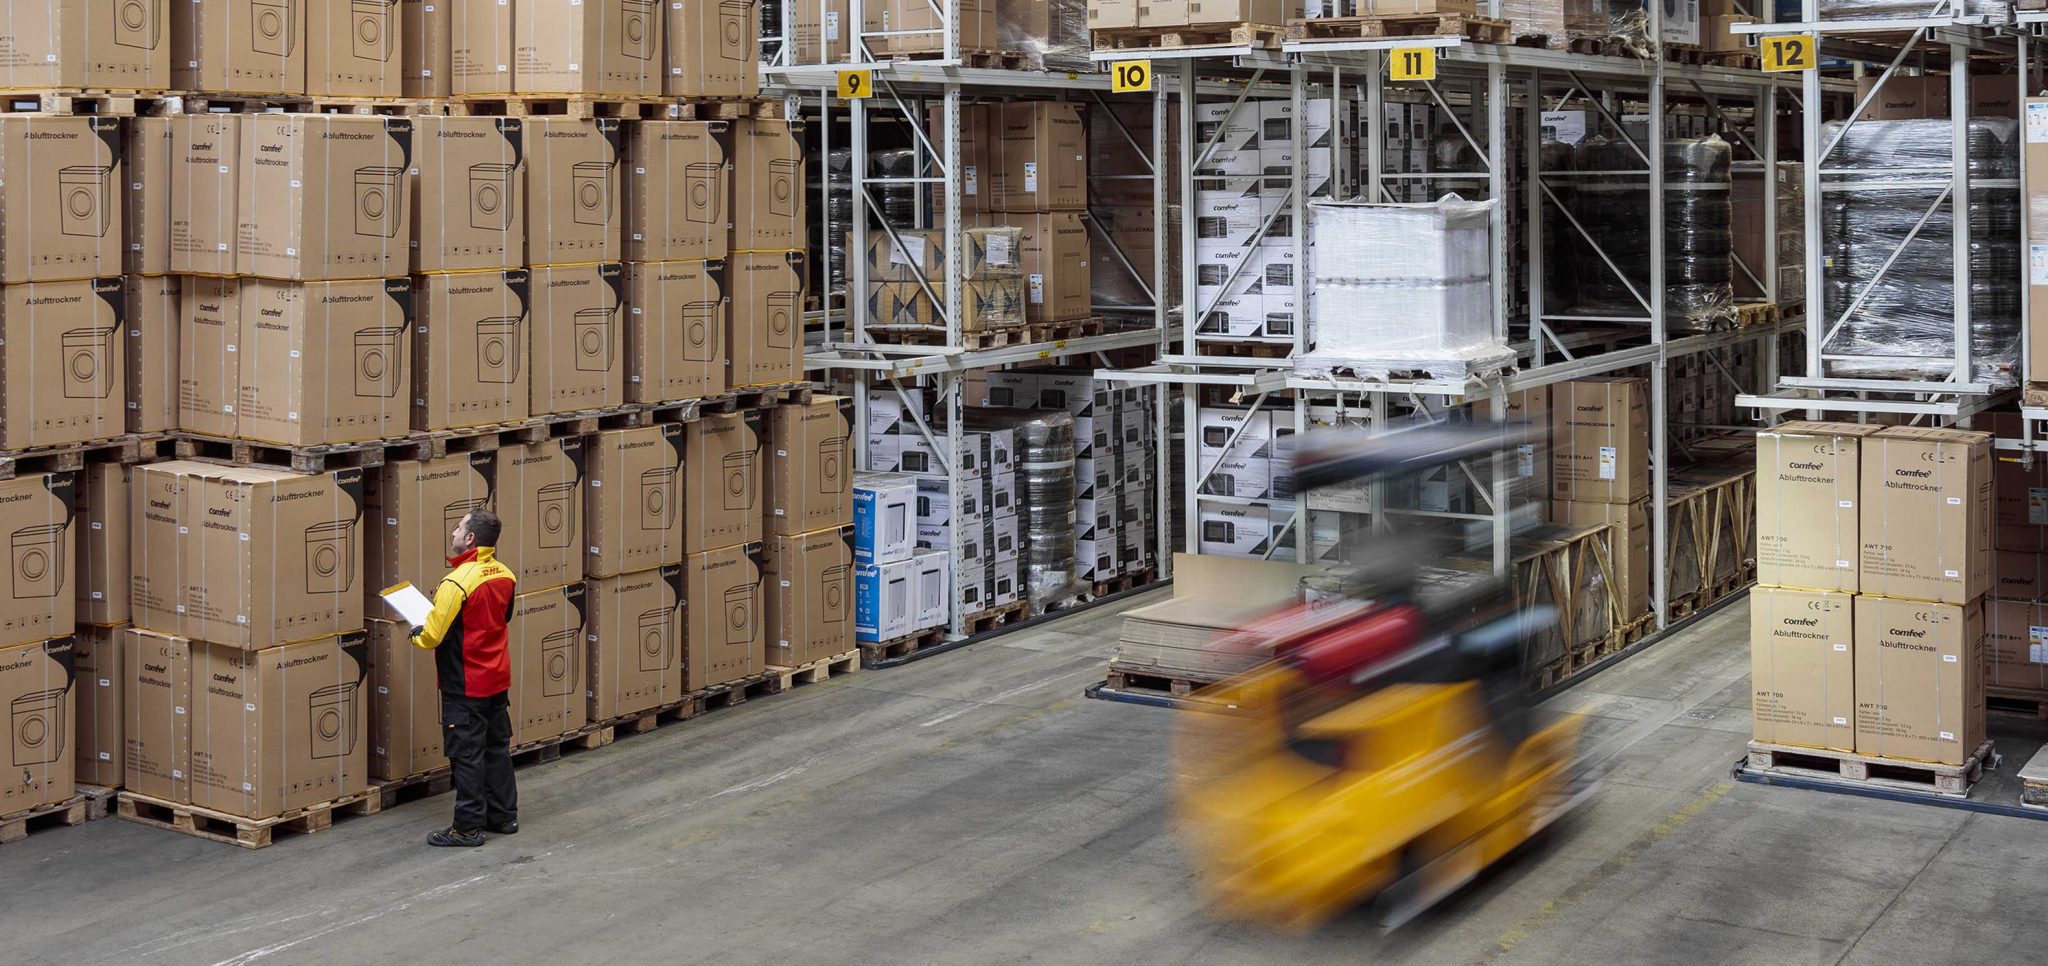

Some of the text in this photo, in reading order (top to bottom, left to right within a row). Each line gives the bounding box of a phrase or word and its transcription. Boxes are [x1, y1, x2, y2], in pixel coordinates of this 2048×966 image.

[1772, 40, 1803, 66] 12
[1404, 52, 1422, 76] 11
[1118, 66, 1144, 88] 10
[848, 74, 860, 94] 9
[747, 130, 780, 138] Alufttrockner
[186, 156, 219, 164] Alufttrockner
[658, 273, 697, 281] Alufttrockner
[194, 316, 226, 327] Ablufttrocknr
[255, 322, 290, 332] blufttrockner
[800, 411, 831, 422] Alufttrockner
[1779, 473, 1835, 484] Ablufttrockner
[1885, 480, 1943, 493] Ablufttrockner
[701, 559, 737, 572] Alufttrockner
[481, 568, 504, 577] DHL
[613, 582, 653, 595] Alufttrockner
[1807, 601, 1820, 610] CE
[1915, 612, 1927, 622] CE
[1773, 629, 1829, 641] Ablufttrockner
[1879, 640, 1937, 652] Ablufttrockner
[138, 675, 172, 689] Ablufttrockne
